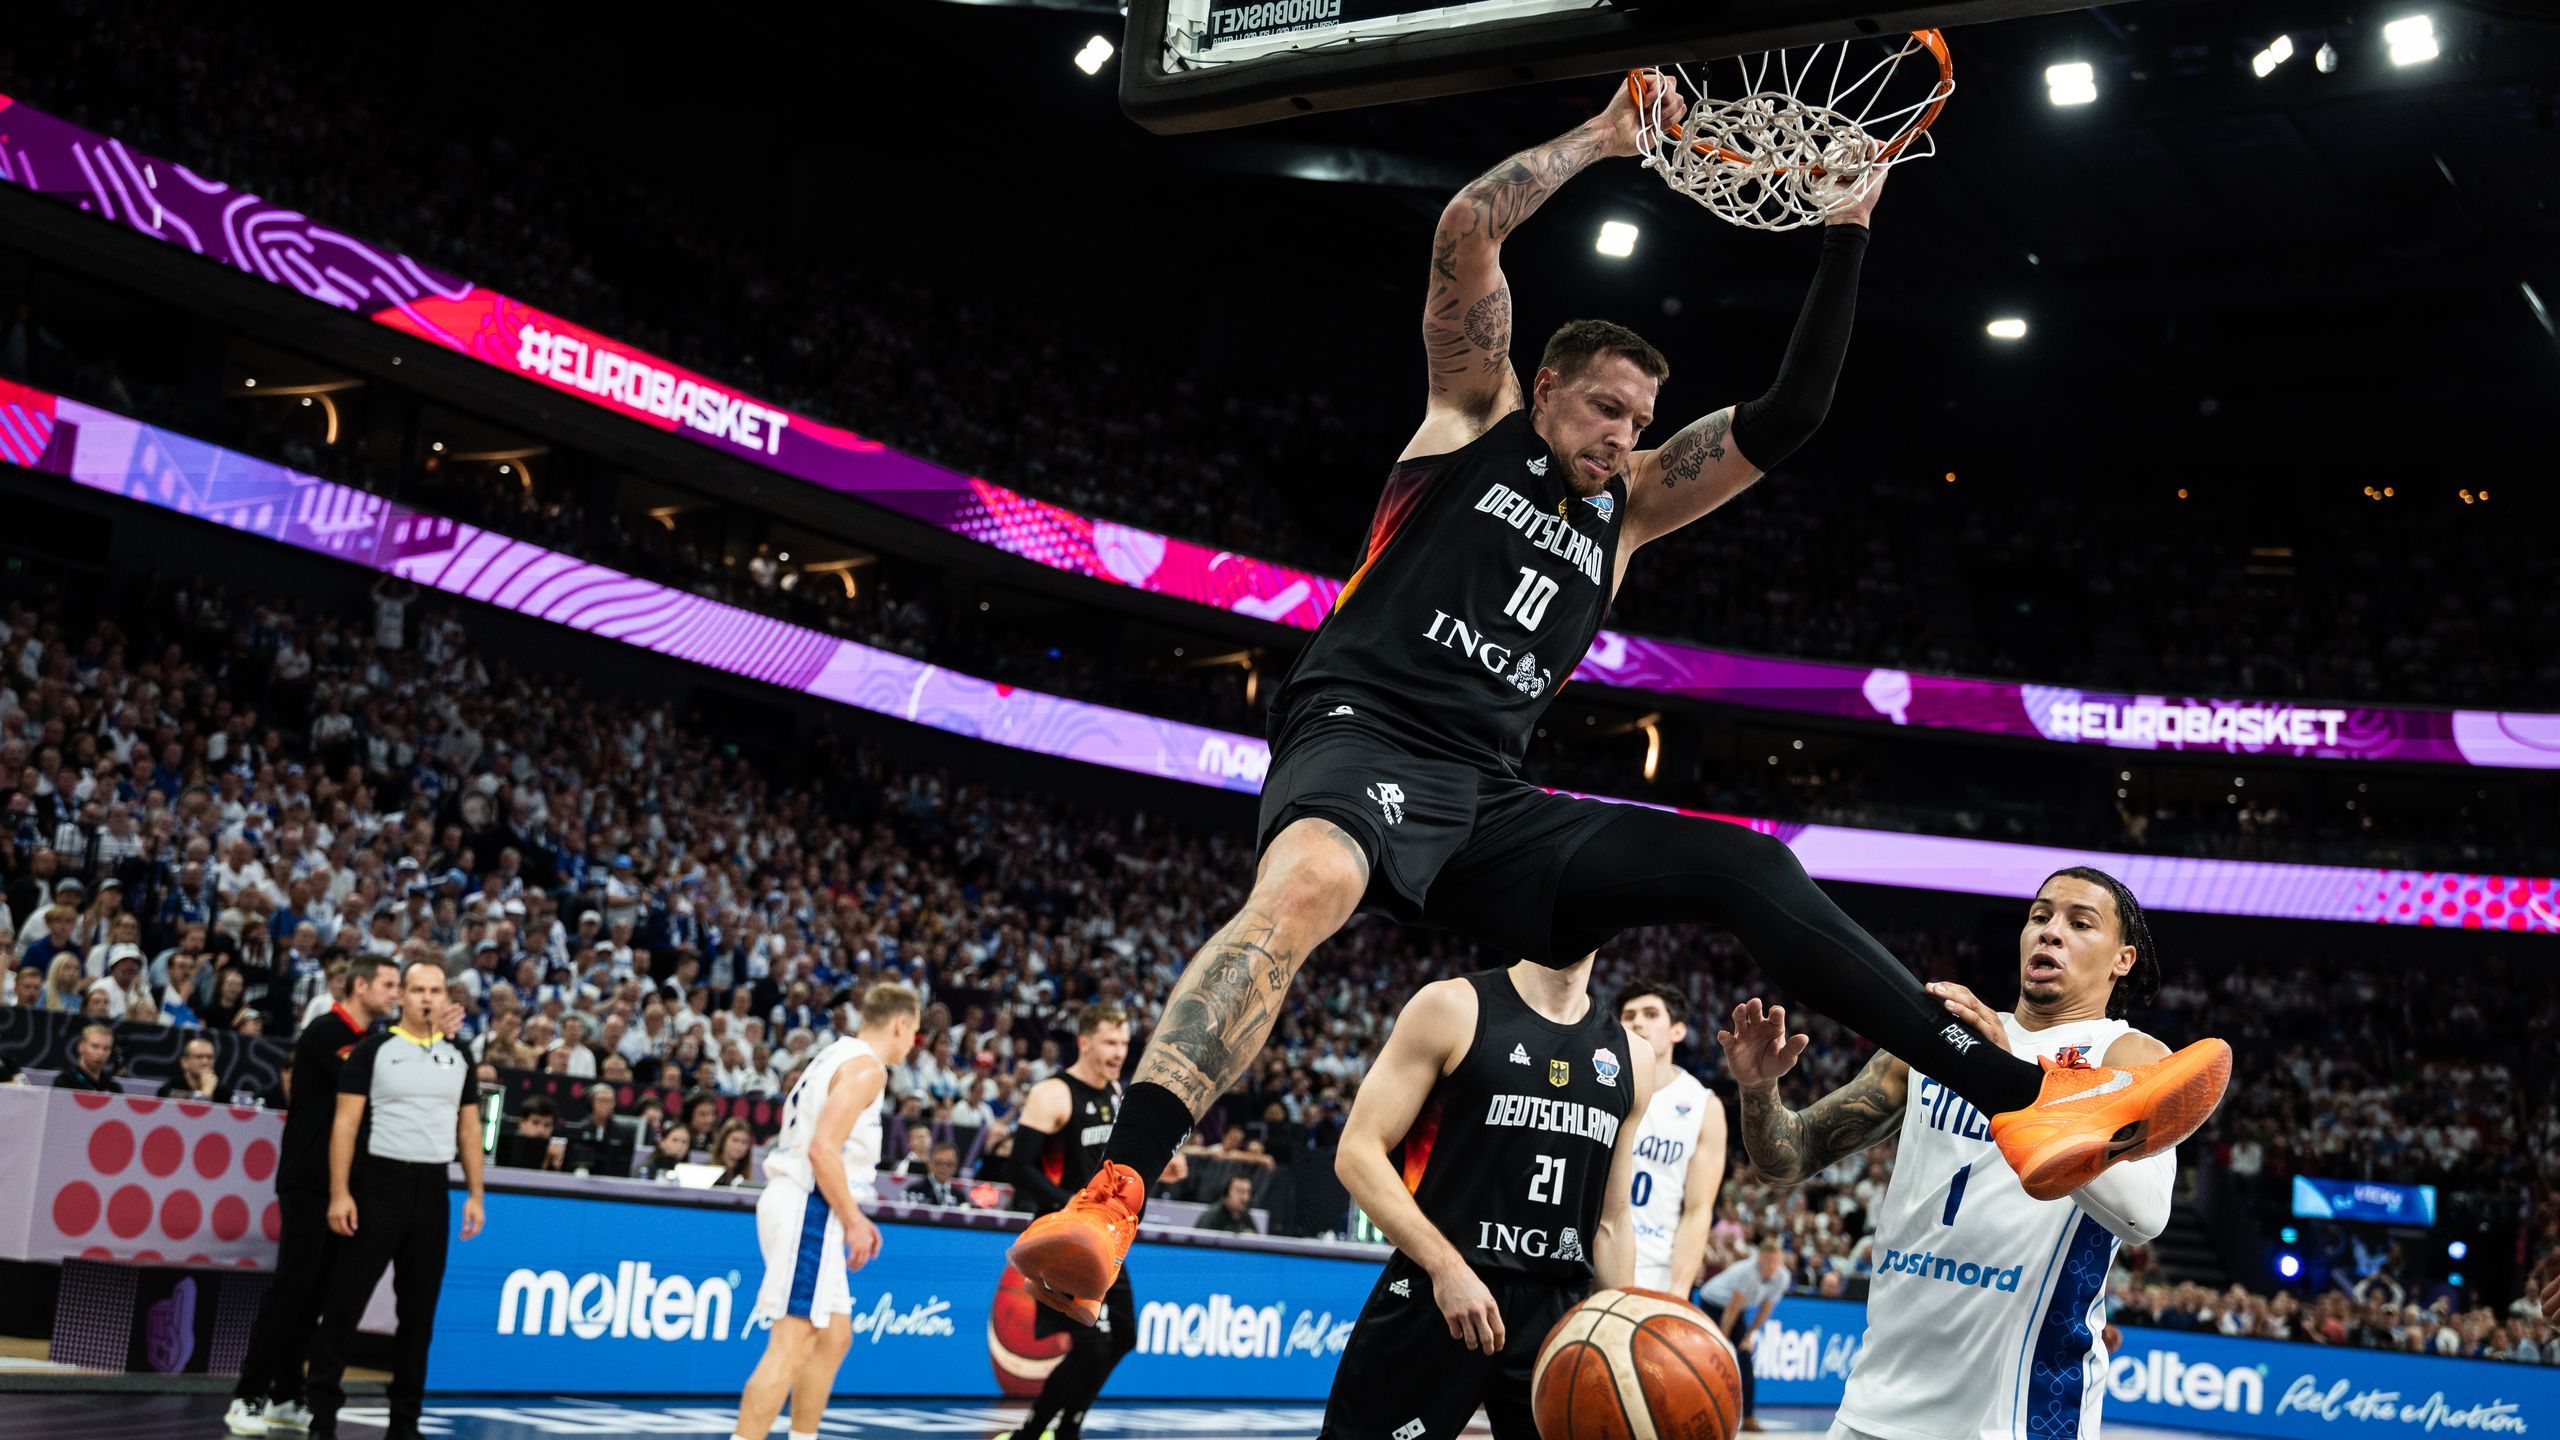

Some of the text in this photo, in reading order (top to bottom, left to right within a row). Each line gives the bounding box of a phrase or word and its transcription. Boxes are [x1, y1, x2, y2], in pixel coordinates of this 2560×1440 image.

[515, 323, 789, 456] #EUROBASKET
[1503, 566, 1560, 632] 10
[1423, 608, 1511, 674] ING
[2050, 701, 2348, 747] #EUROBASKET
[1938, 1022, 1982, 1056] PEAK
[1485, 1094, 1619, 1149] DEUTSCHLAND
[1527, 1154, 1567, 1206] 21
[1941, 1161, 1973, 1227] 1
[1477, 1221, 1548, 1258] ING
[1876, 1248, 2024, 1293] postnord
[497, 1260, 734, 1342] molten
[1135, 1293, 1282, 1359] molten
[2105, 1349, 2264, 1416] olten
